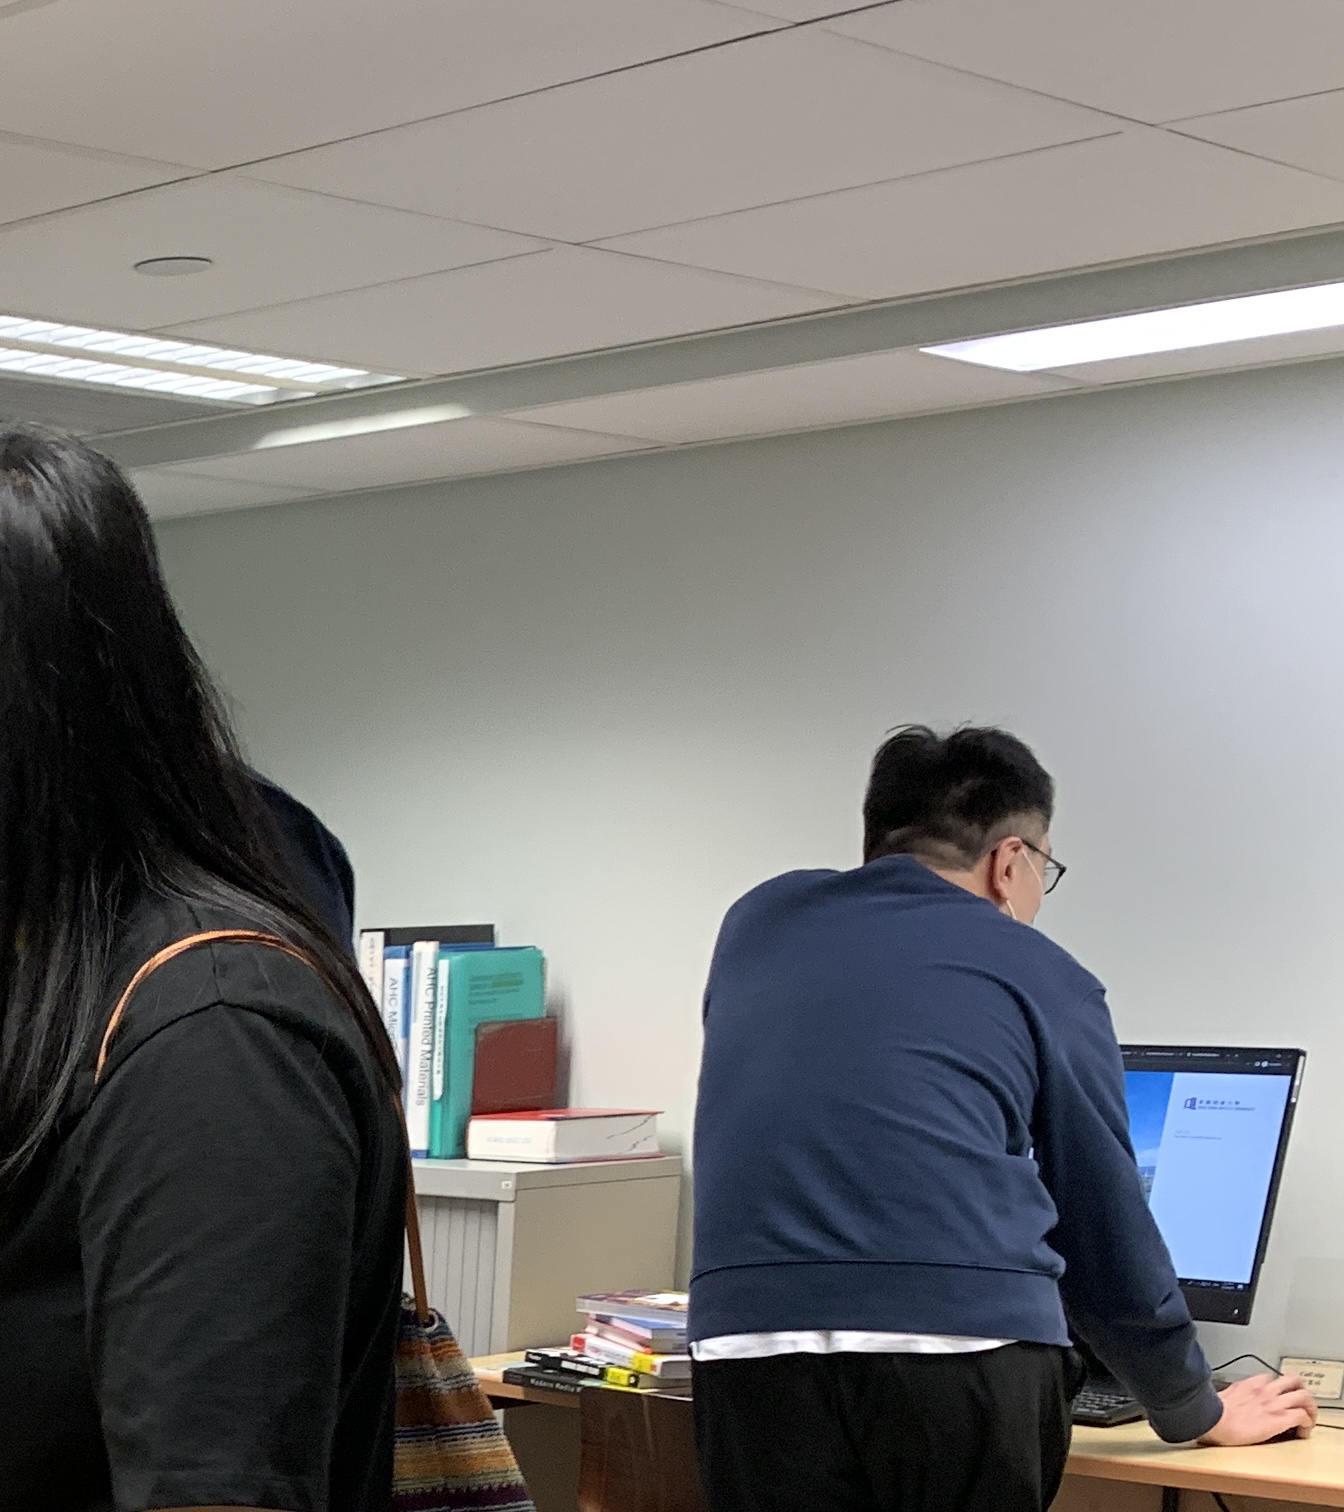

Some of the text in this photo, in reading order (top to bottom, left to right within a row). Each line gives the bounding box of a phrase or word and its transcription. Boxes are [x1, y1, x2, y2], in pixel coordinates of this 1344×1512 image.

[388, 977, 398, 1007] AHC
[415, 967, 437, 1107] AHC Printed Materials
